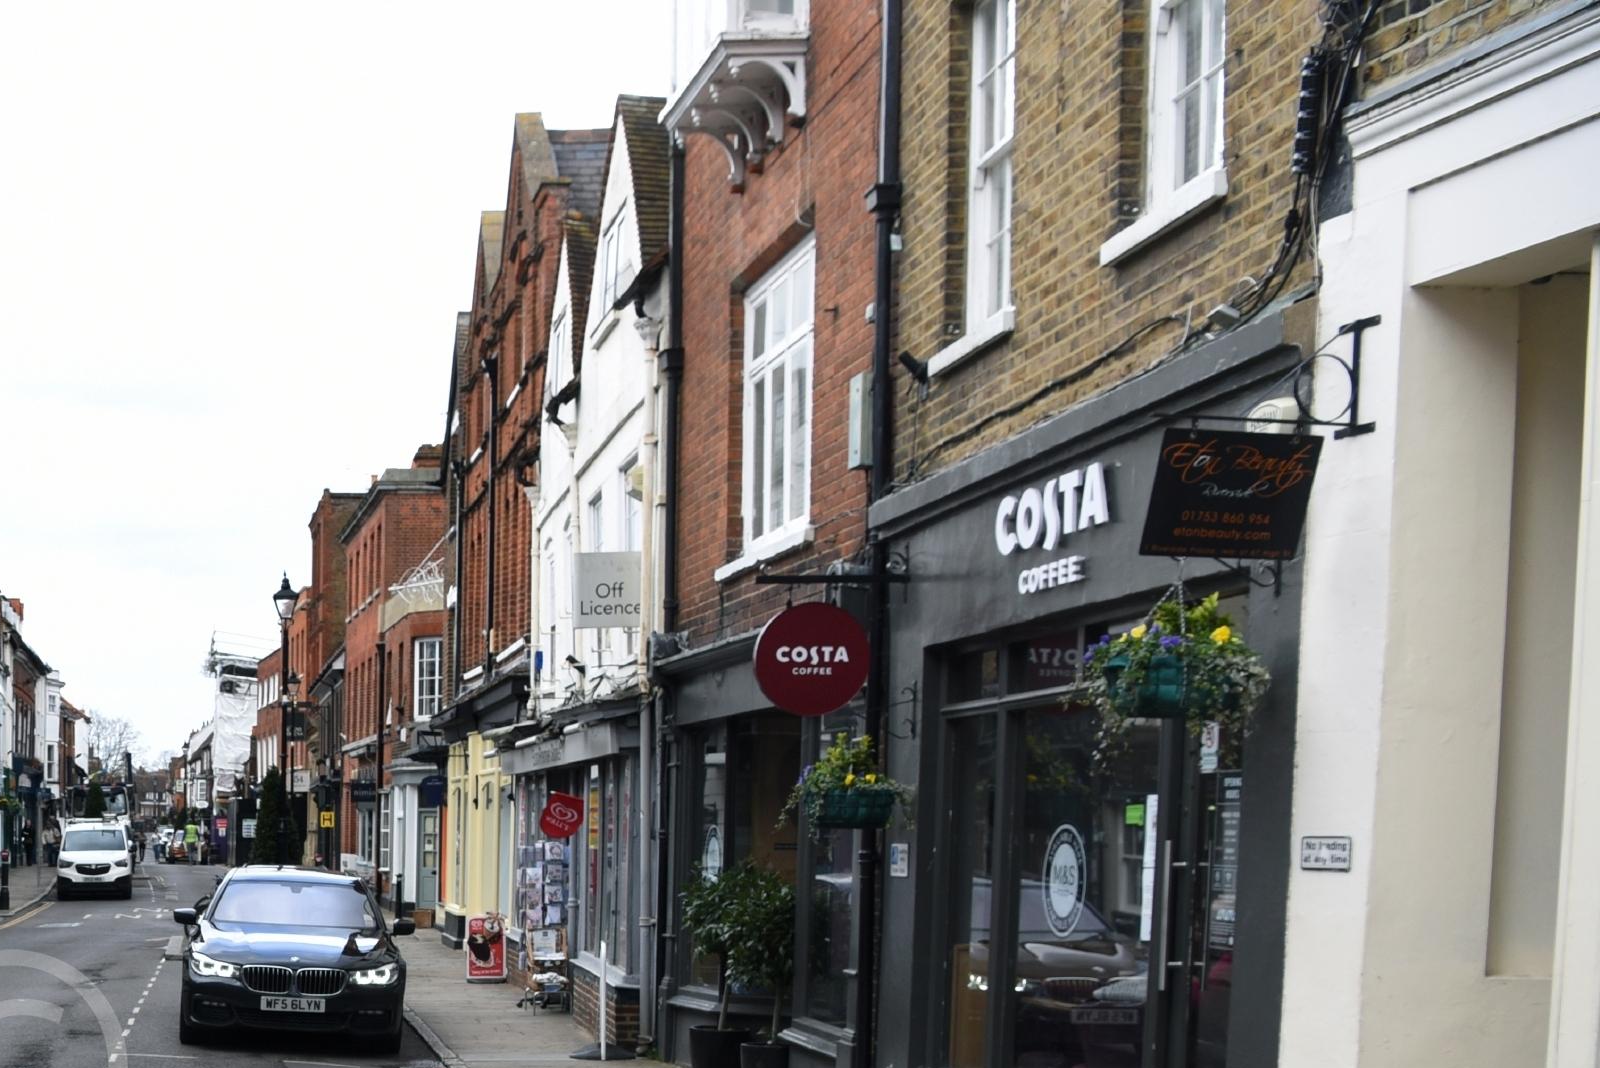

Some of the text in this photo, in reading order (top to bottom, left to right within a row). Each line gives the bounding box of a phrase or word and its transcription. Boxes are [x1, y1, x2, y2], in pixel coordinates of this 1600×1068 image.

[995, 462, 1110, 556] COSTA
[1181, 510, 1218, 524] 01753
[1222, 512, 1244, 524] 860
[1173, 527, 1272, 541] etonbeauty.com
[1018, 555, 1087, 595] COFFEE
[595, 582, 625, 599] Off
[580, 600, 640, 616] Licence
[775, 646, 849, 666] COSTA
[791, 667, 833, 676] COFFEE
[1053, 865, 1076, 886] M&S
[290, 999, 321, 1011] 6LYN
